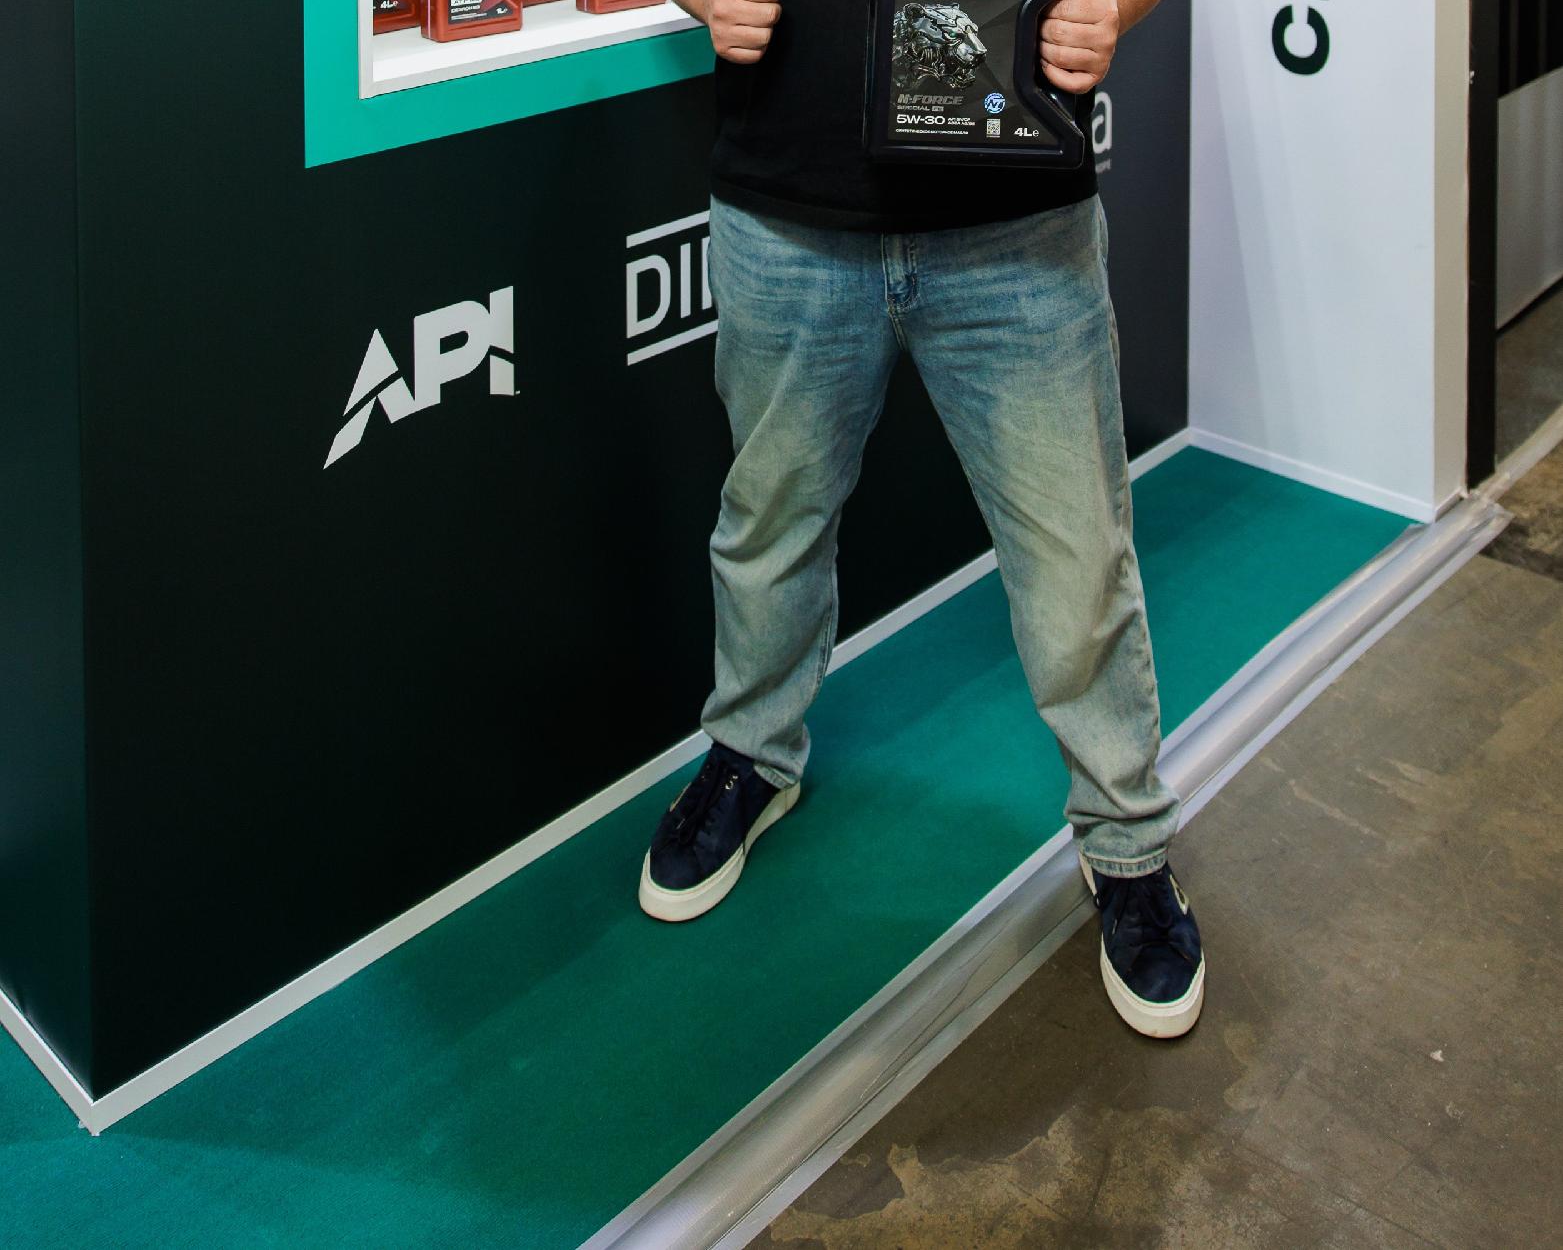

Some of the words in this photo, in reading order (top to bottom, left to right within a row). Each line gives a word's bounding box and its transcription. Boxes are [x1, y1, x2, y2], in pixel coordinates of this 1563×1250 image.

[896, 93, 964, 105] N-FORCE
[896, 114, 945, 125] 5W-30
[322, 285, 515, 470] API
